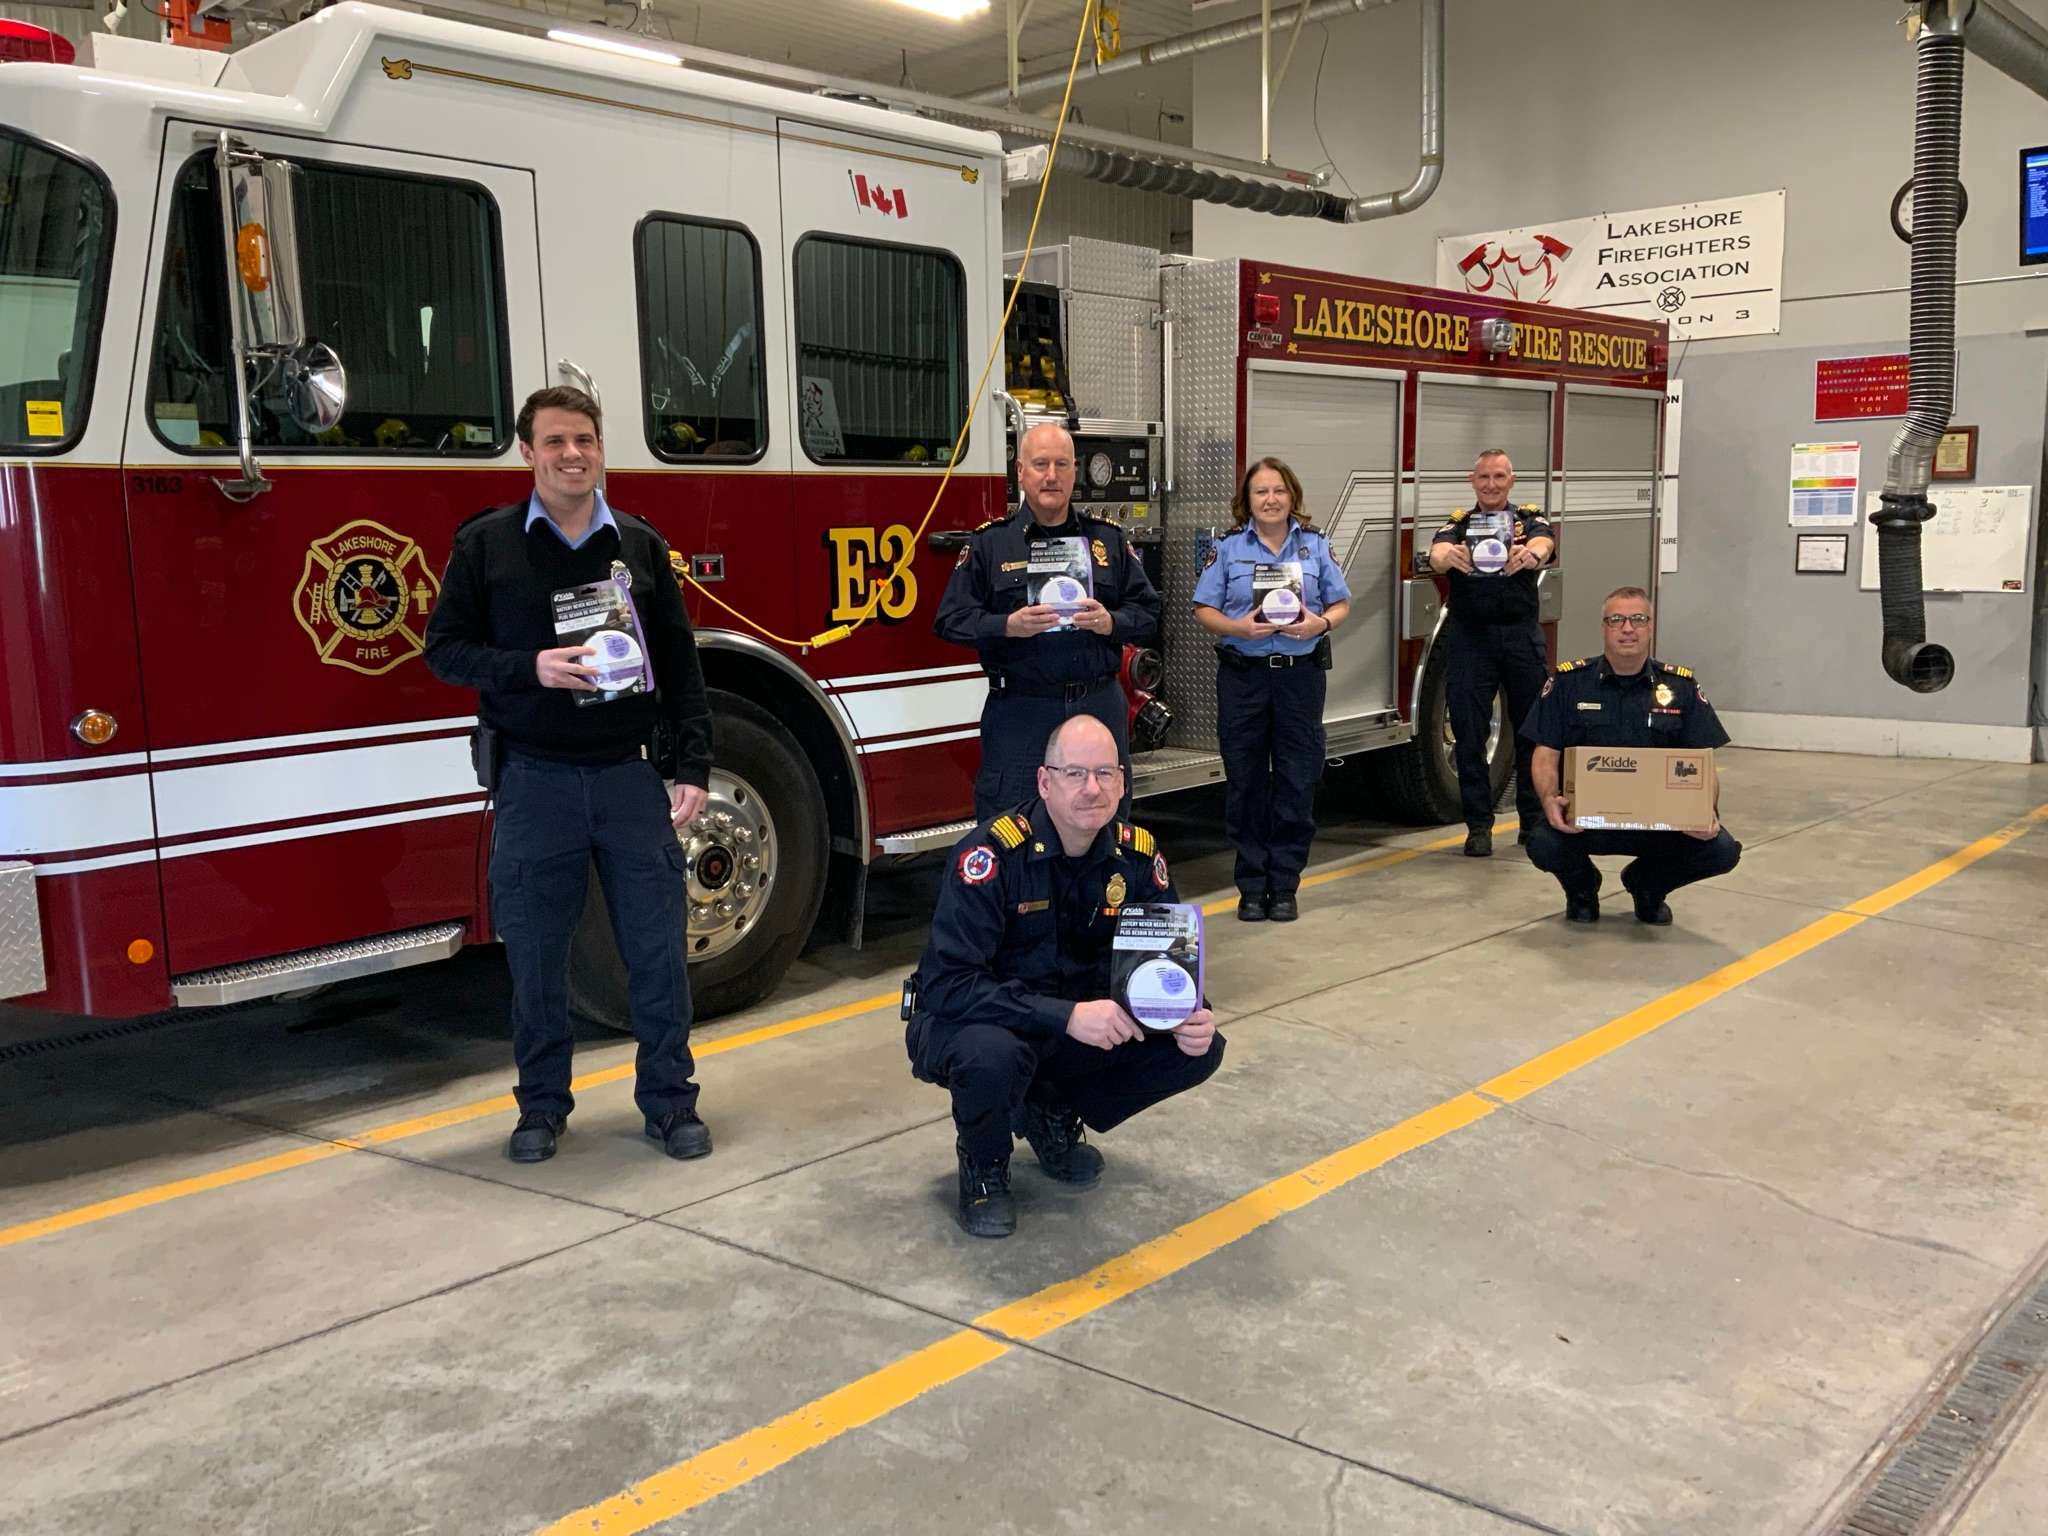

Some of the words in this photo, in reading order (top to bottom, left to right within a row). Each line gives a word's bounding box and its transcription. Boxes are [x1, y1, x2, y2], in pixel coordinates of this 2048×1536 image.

[1607, 210, 1743, 240] LAKESHORE
[1597, 235, 1751, 266] FIREFIGHTERS
[1595, 261, 1750, 290] ASSOCIATION
[1735, 309, 1750, 320] 3
[1293, 294, 1470, 352] LAKESHORE
[1508, 322, 1562, 361] FIRE
[1568, 330, 1647, 369] RESCUE
[132, 475, 184, 495] 3163
[330, 535, 397, 557] LAKESHORE
[828, 523, 918, 622] E3
[355, 645, 392, 660] FIRE
[1601, 756, 1638, 768] Kidde
